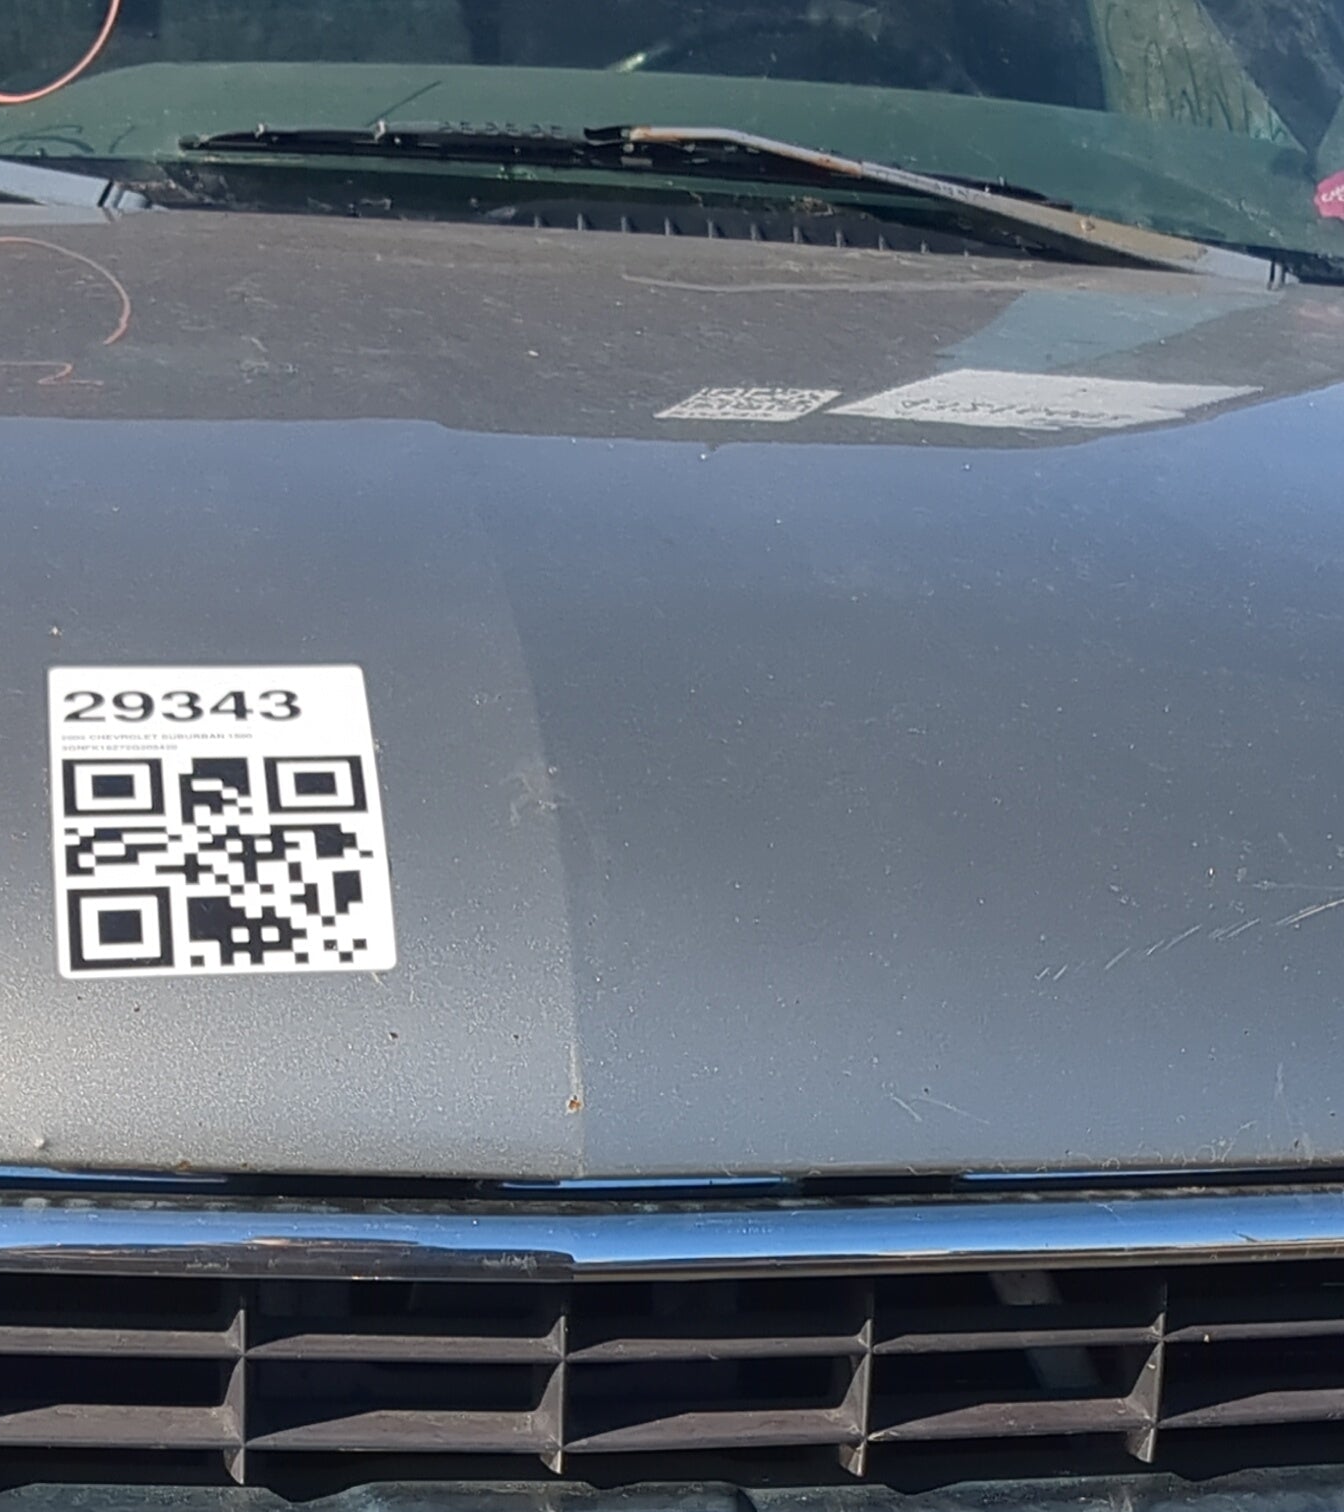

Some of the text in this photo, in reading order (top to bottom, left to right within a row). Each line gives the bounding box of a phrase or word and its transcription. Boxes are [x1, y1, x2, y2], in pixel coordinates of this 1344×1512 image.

[63, 690, 302, 722] 29343
[88, 733, 158, 741] CHEVROLET
[161, 733, 225, 741] SUBURBAN
